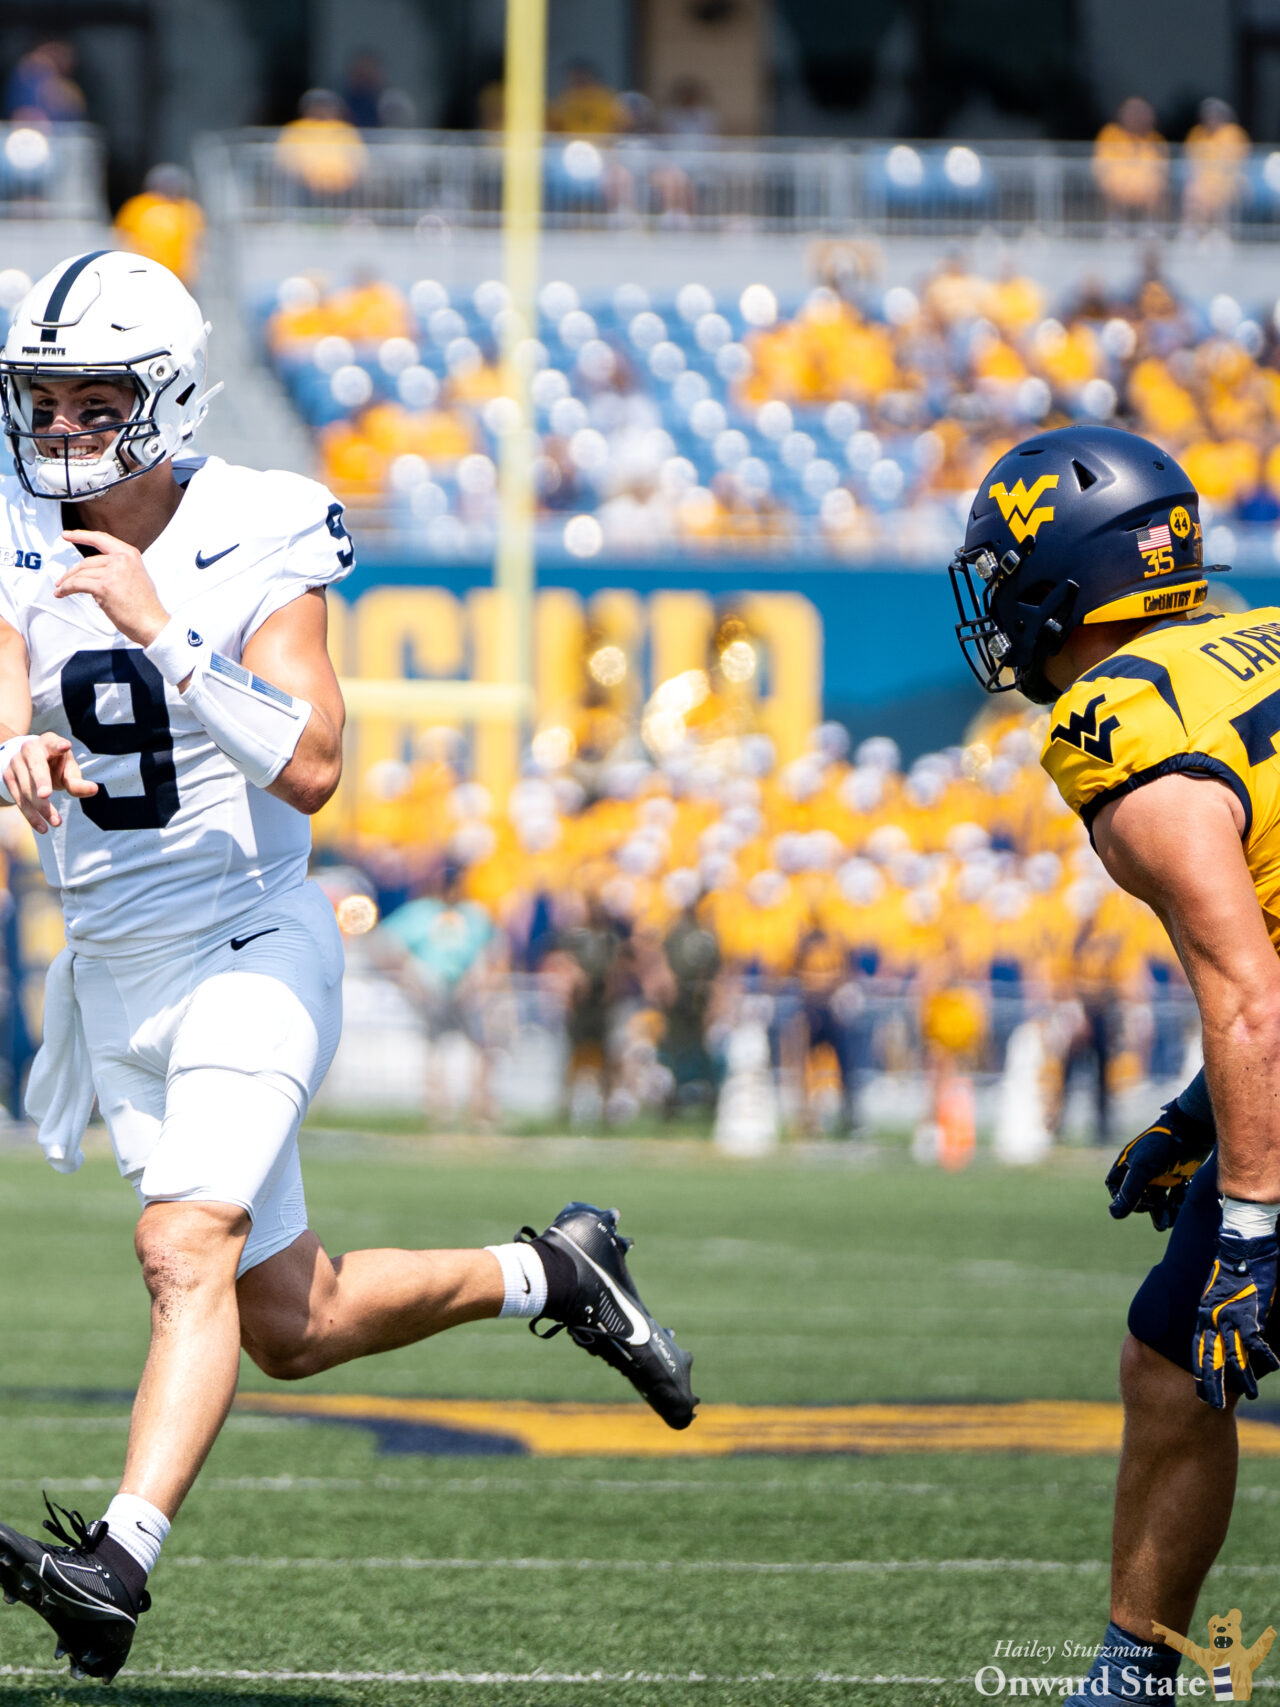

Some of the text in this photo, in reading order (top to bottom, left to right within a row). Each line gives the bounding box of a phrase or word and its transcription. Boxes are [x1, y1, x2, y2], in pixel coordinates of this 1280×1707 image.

[42, 347, 66, 356] STATE
[325, 502, 354, 568] 9
[1173, 517, 1189, 532] 44
[1141, 545, 1175, 578] 35
[61, 648, 181, 831] 9
